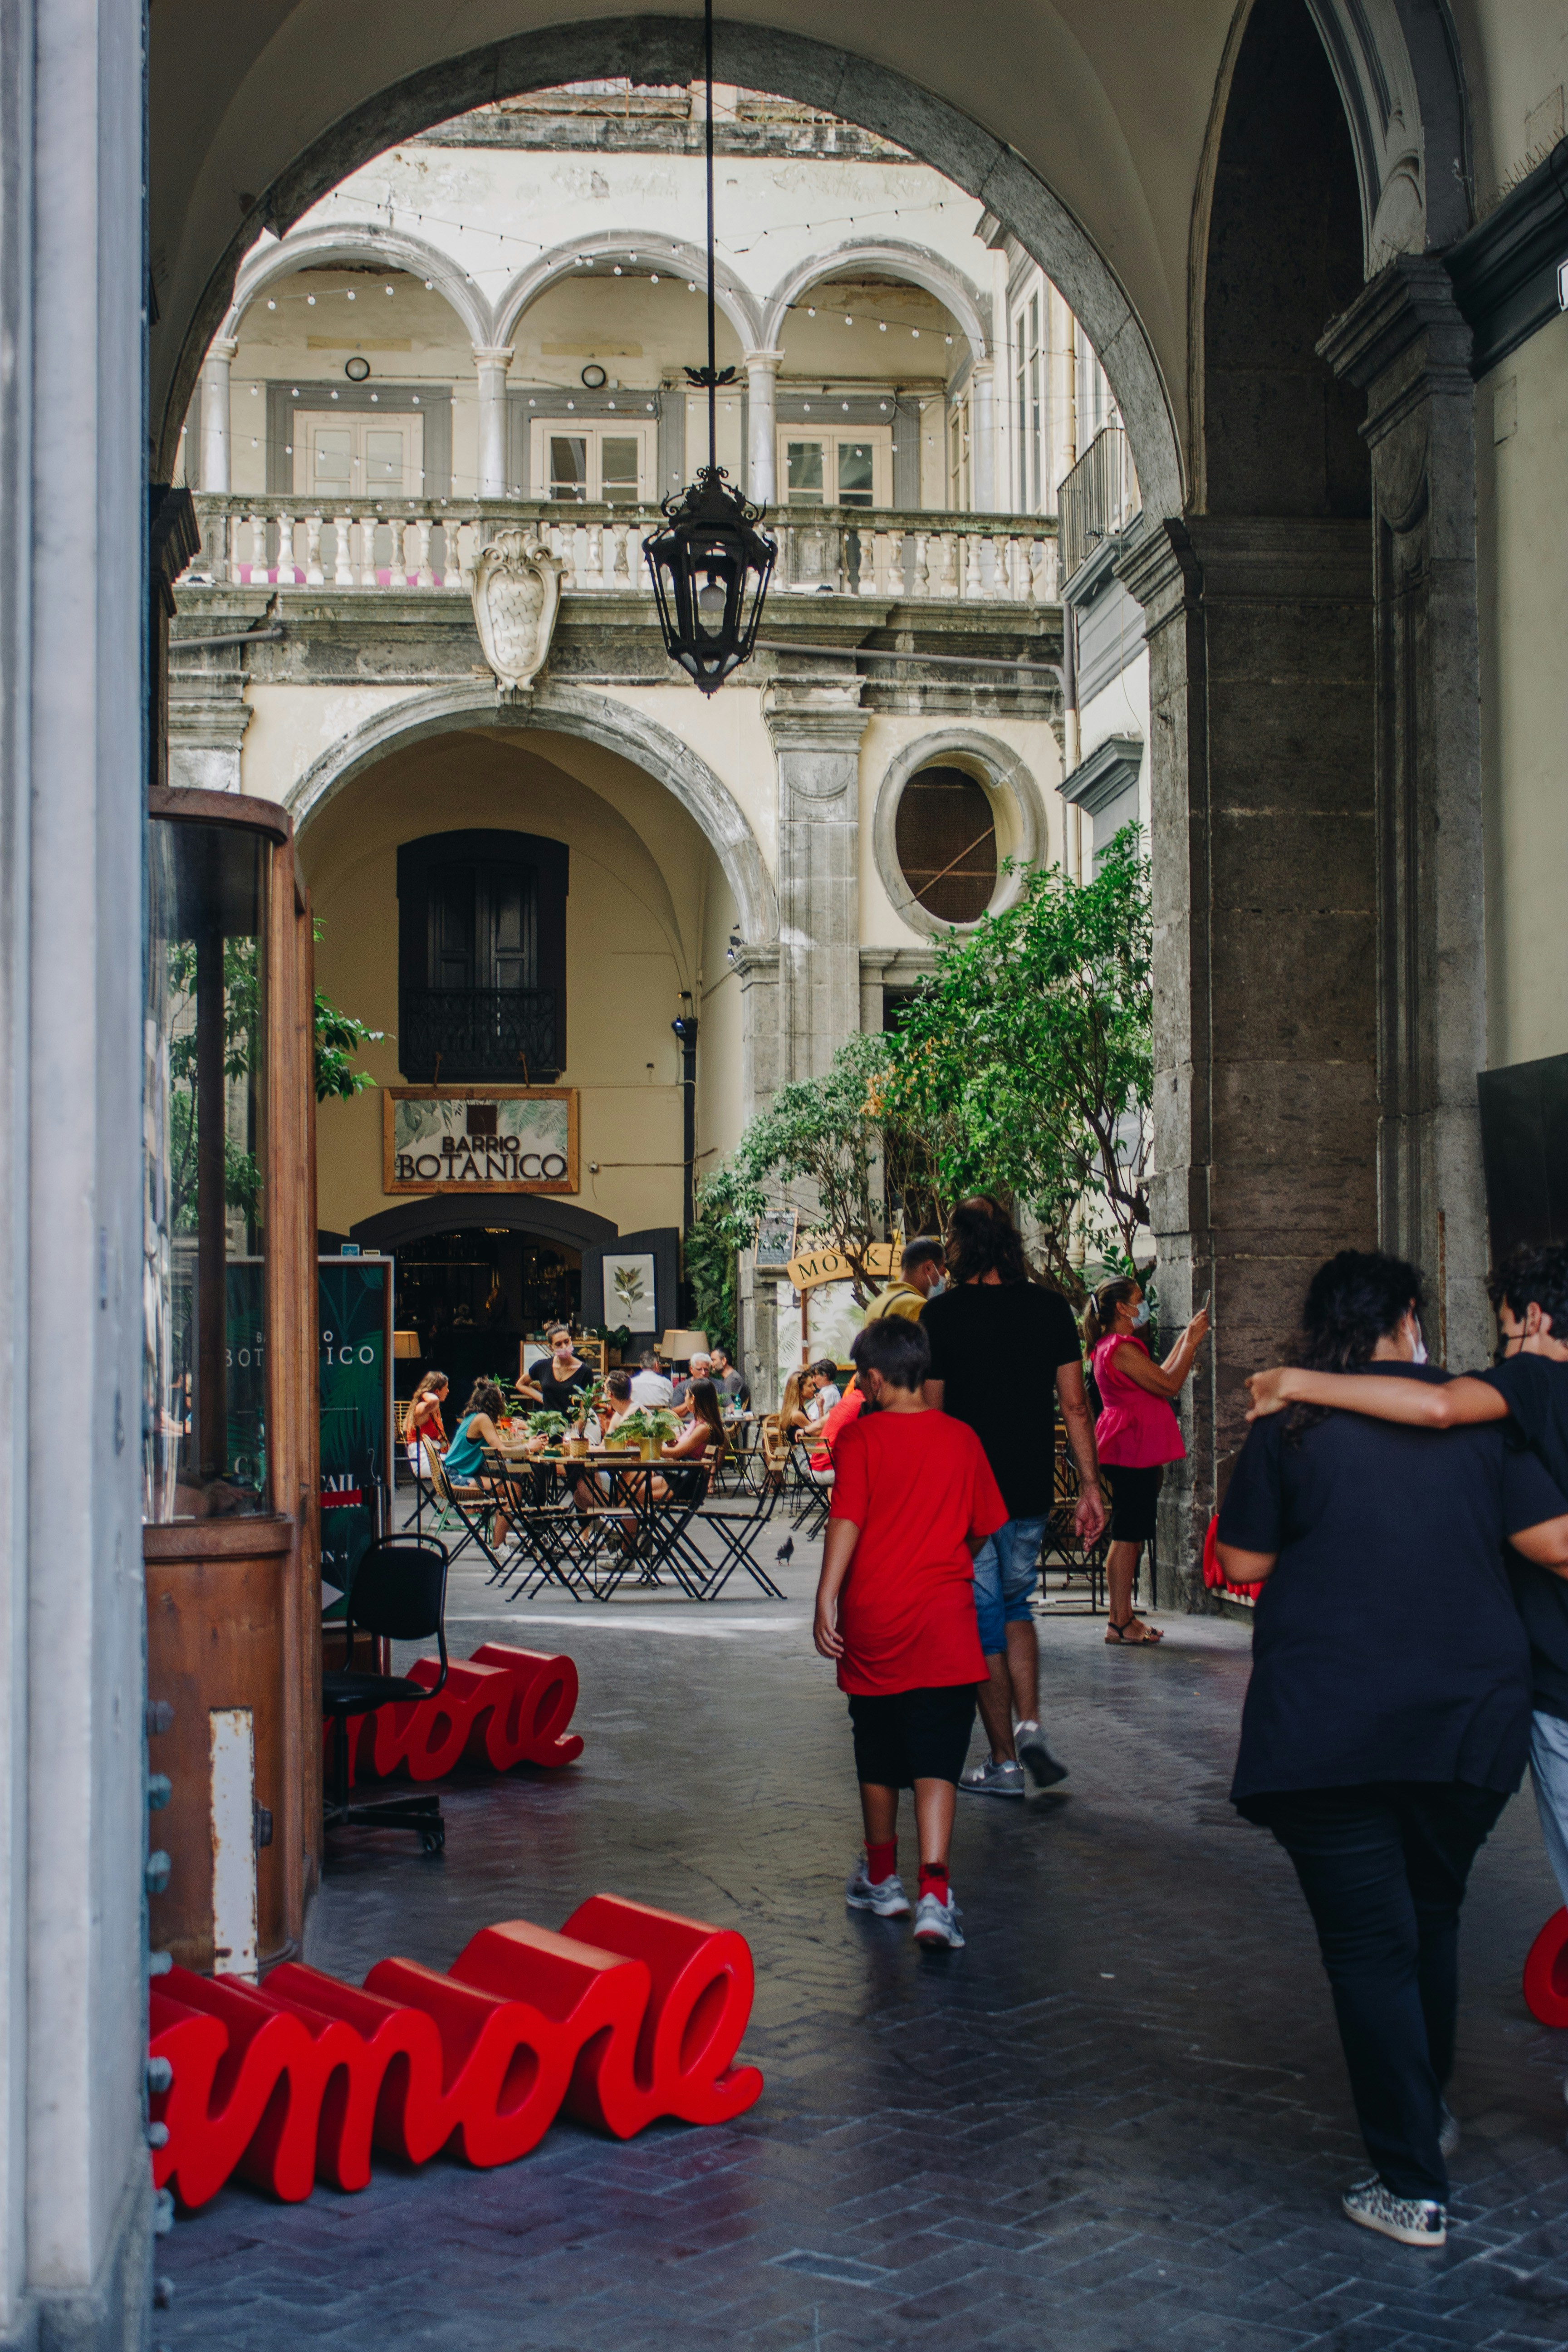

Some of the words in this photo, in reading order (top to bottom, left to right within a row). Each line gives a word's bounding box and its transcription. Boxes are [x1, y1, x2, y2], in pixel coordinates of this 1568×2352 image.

[443, 1136, 520, 1153] BARRIO
[397, 1154, 567, 1179] BOTANICO
[797, 1248, 902, 1280] MOKE
